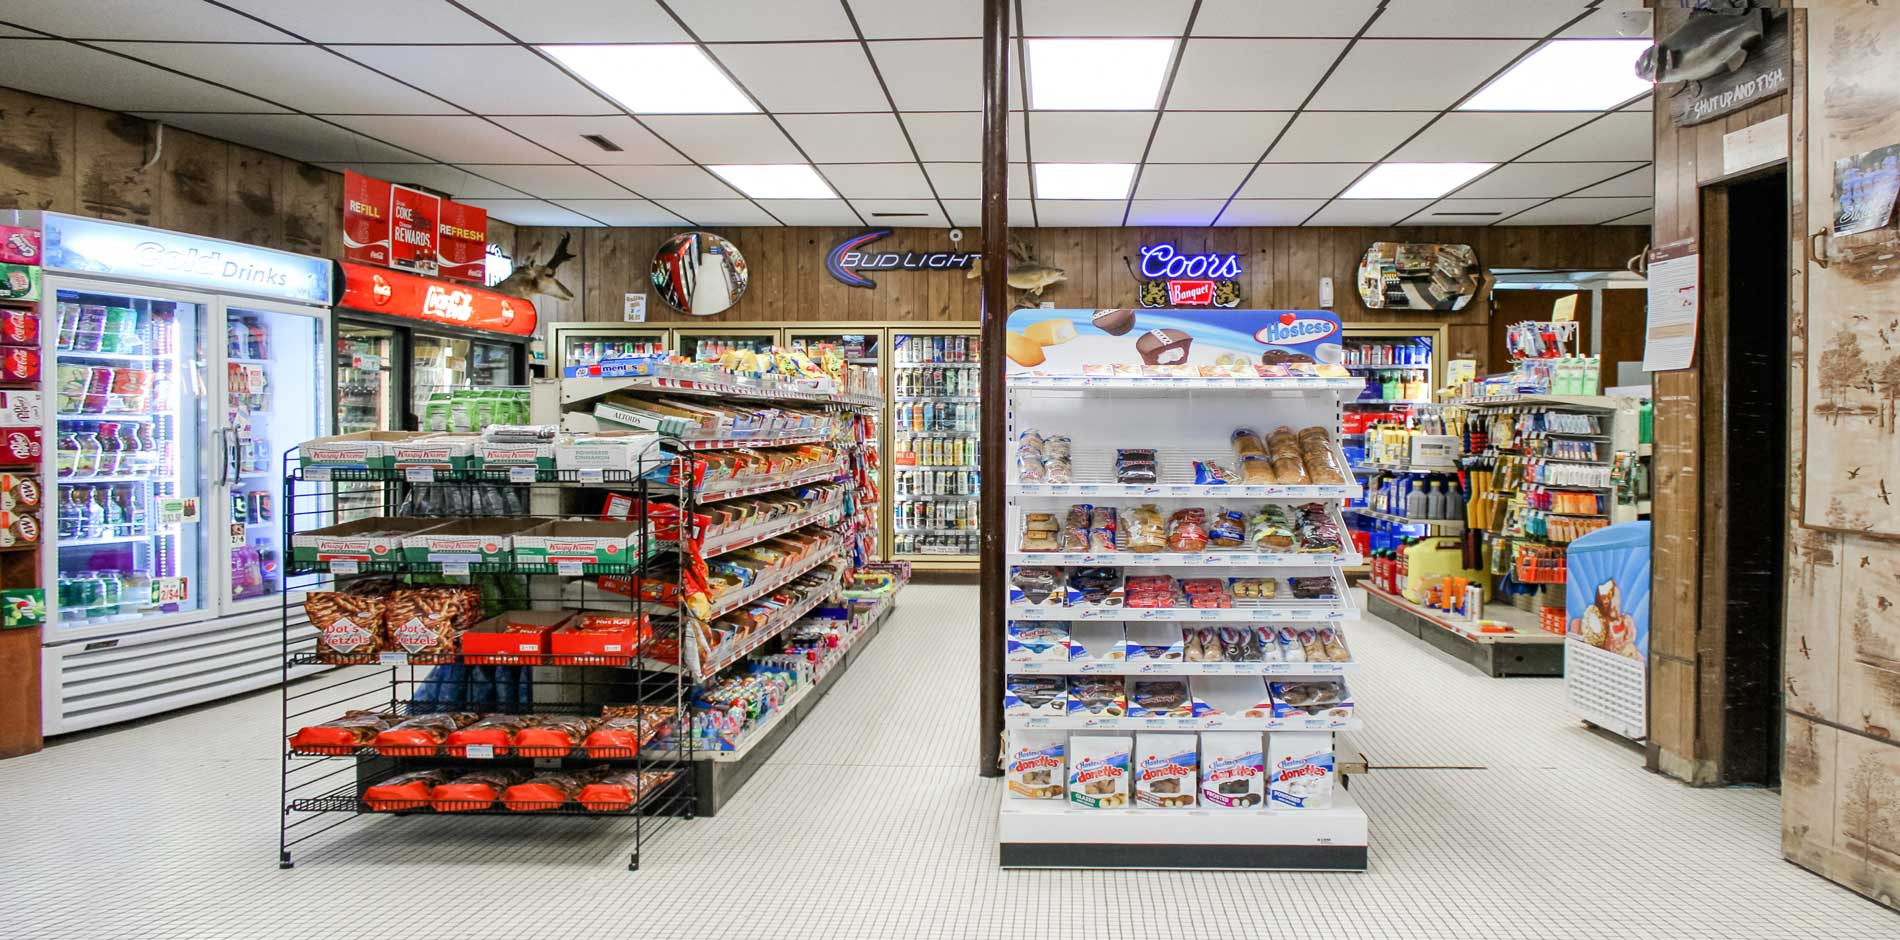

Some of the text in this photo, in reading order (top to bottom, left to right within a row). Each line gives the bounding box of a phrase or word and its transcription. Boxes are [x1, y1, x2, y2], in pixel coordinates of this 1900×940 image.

[1695, 68, 1785, 120] SHUT UP AND FISH.
[350, 200, 380, 218] REFILL
[395, 226, 432, 248] REWARDS.
[440, 224, 484, 242] REFRESH
[135, 241, 287, 287] Cold Drinks
[1141, 245, 1242, 278] Coors
[1174, 284, 1209, 301] Banquet
[1267, 321, 1332, 342] Hostess
[602, 364, 638, 373] mentos
[613, 411, 642, 425] ALTOIDS
[326, 624, 360, 634] Dot's
[399, 624, 427, 634] Dot's
[322, 635, 370, 645] Pretzels
[394, 635, 437, 645] Pretzels
[1016, 756, 1060, 772] donettes
[1143, 763, 1189, 781] donettes
[1210, 764, 1256, 781] donettes
[1280, 764, 1326, 781] donettes
[1078, 765, 1123, 783] donettes
